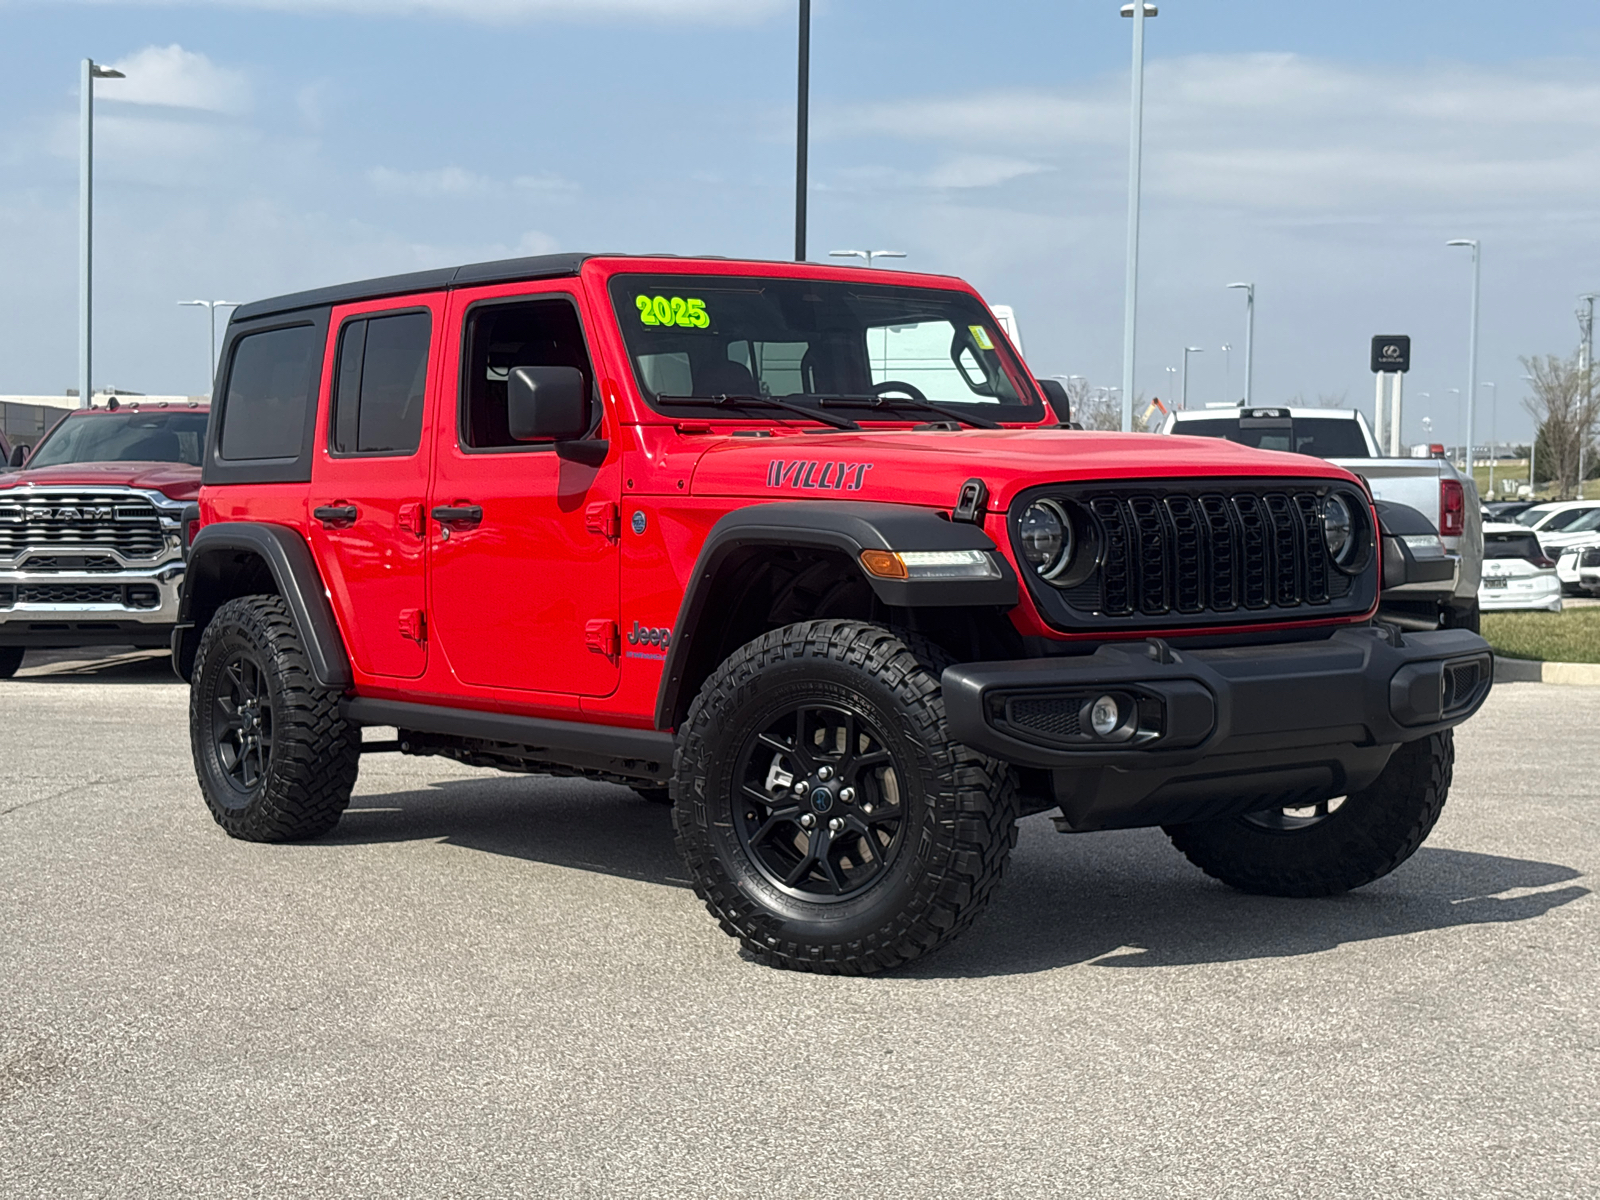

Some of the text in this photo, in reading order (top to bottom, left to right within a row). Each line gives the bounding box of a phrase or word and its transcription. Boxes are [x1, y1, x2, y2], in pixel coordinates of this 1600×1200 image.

[636, 295, 710, 328] 2025
[766, 460, 874, 491] WILLYS
[25, 506, 113, 520] RAM
[627, 620, 671, 651] Jeep
